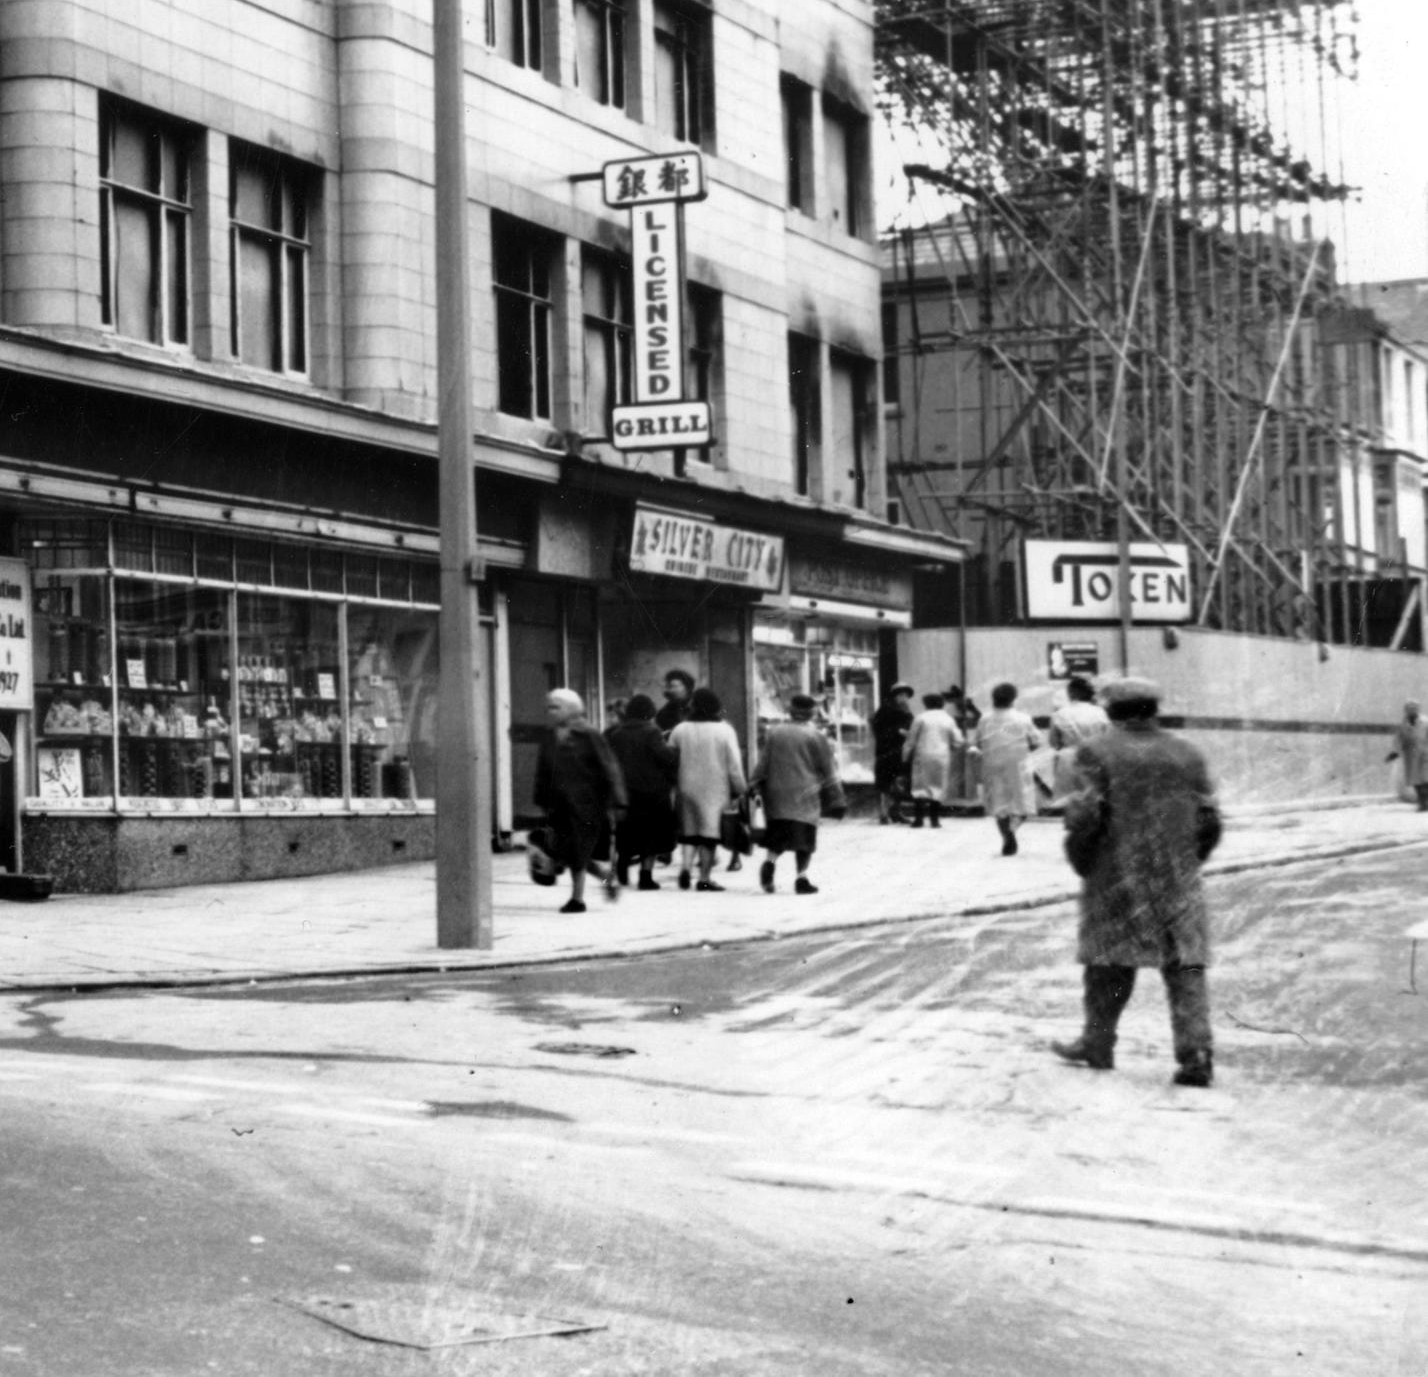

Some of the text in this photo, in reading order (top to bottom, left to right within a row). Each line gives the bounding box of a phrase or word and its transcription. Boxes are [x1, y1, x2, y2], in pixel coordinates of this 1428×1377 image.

[616, 160, 689, 201] 銀都
[644, 210, 671, 396] LICENSED
[614, 414, 708, 438] GRILL
[649, 518, 766, 571] SILVER CITY
